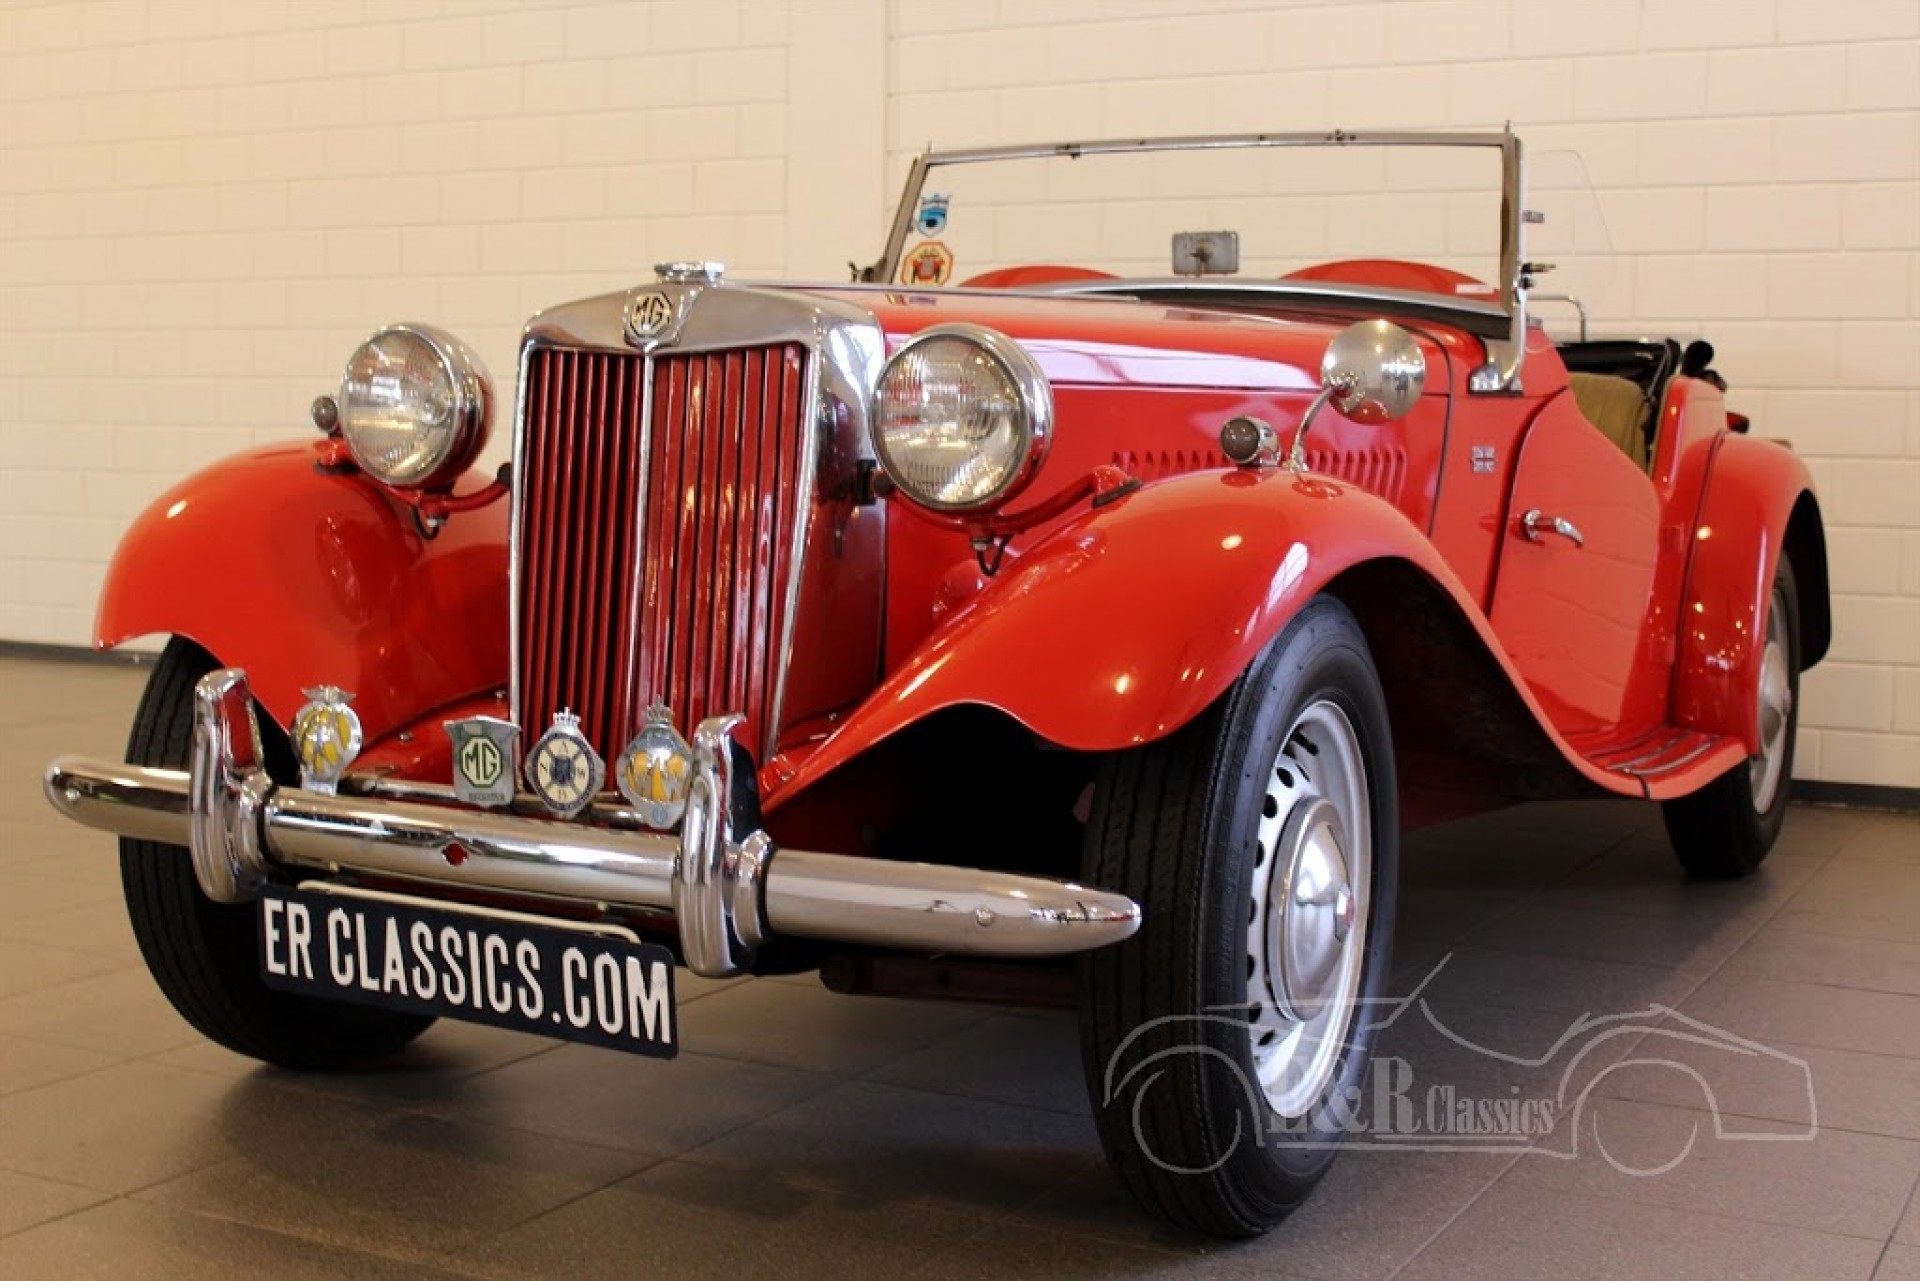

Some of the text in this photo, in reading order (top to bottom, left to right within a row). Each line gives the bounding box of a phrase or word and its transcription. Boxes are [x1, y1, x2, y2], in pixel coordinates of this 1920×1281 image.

[633, 294, 666, 330] MG
[464, 741, 498, 781] MG
[264, 898, 671, 1044] ER CLASSICS.COM
